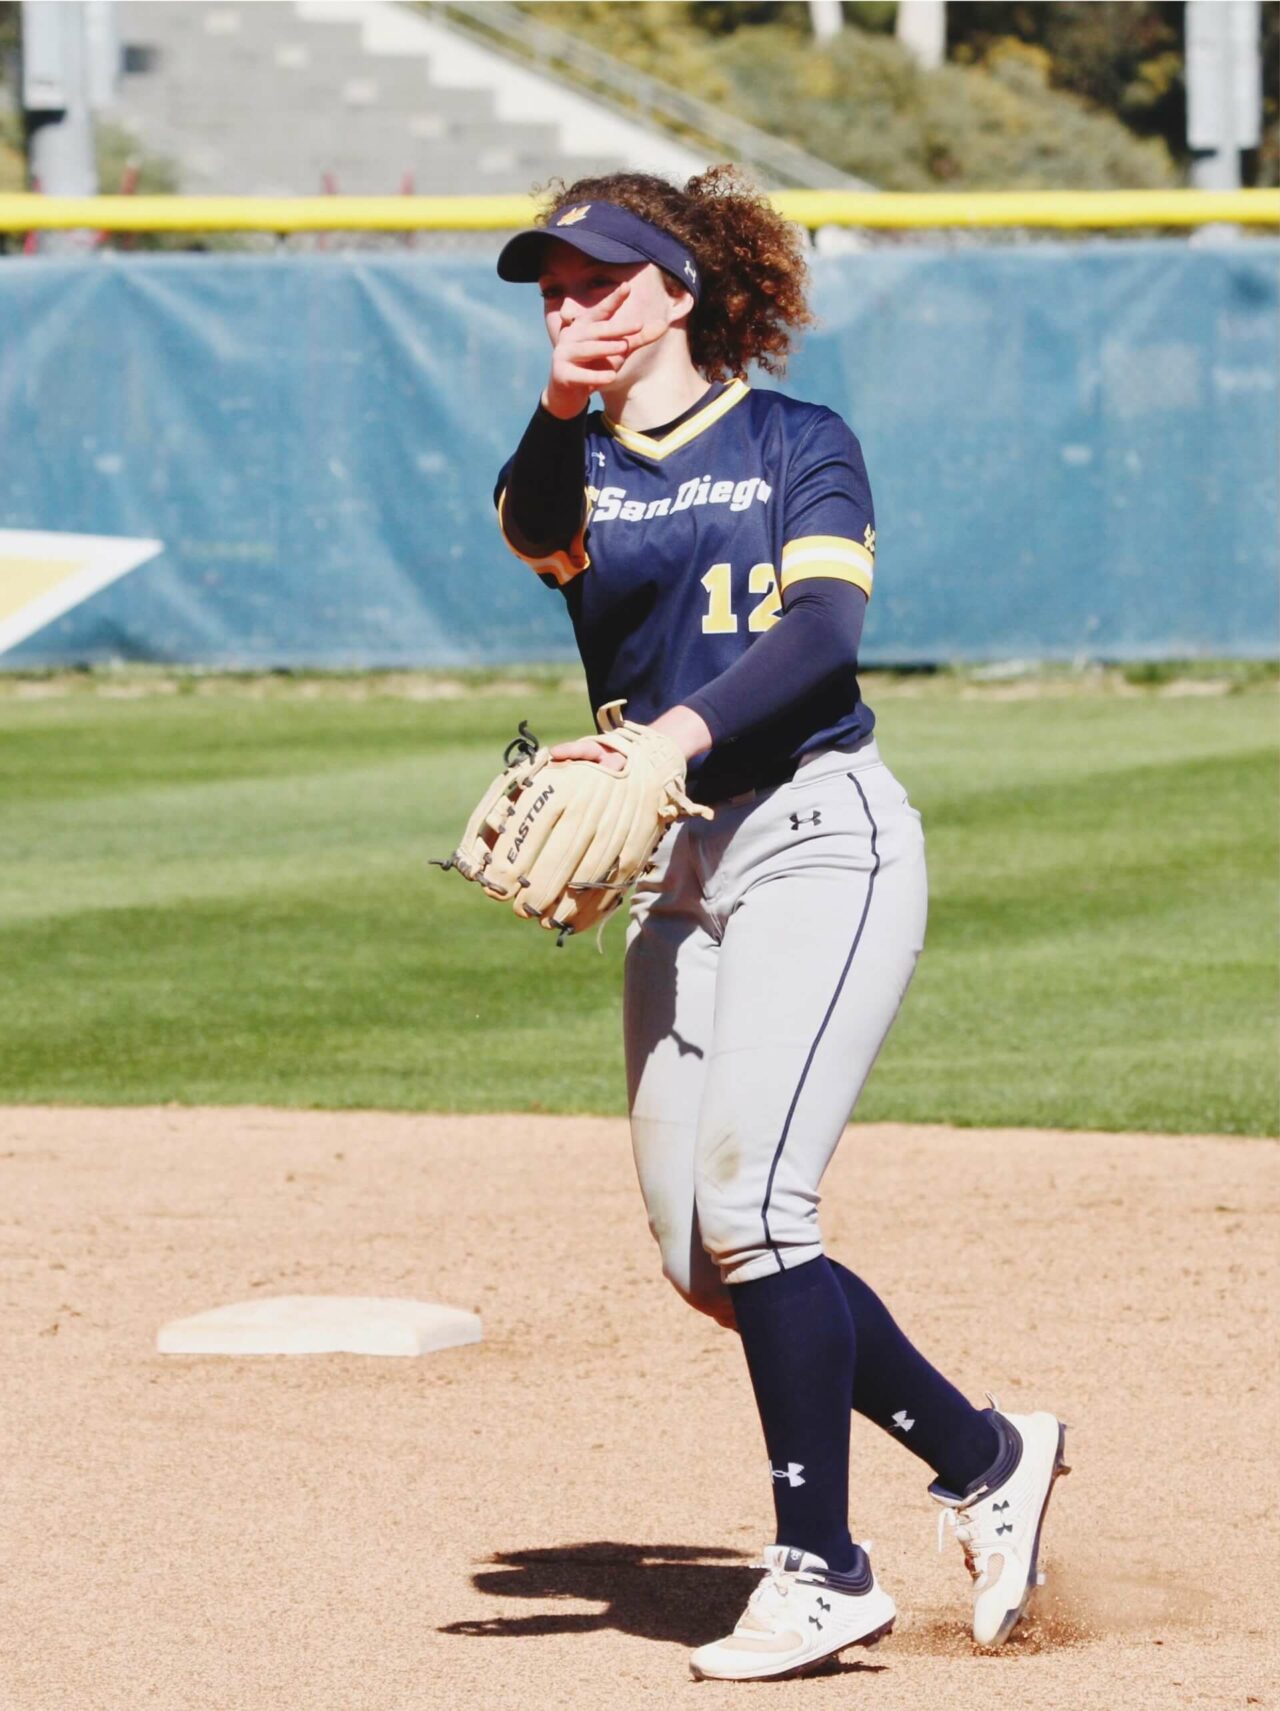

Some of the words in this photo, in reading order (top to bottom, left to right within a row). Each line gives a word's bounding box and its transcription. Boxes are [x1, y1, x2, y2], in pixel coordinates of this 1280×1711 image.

[593, 487, 671, 522] San
[701, 563, 783, 634] 12
[507, 785, 555, 864] EASTON
